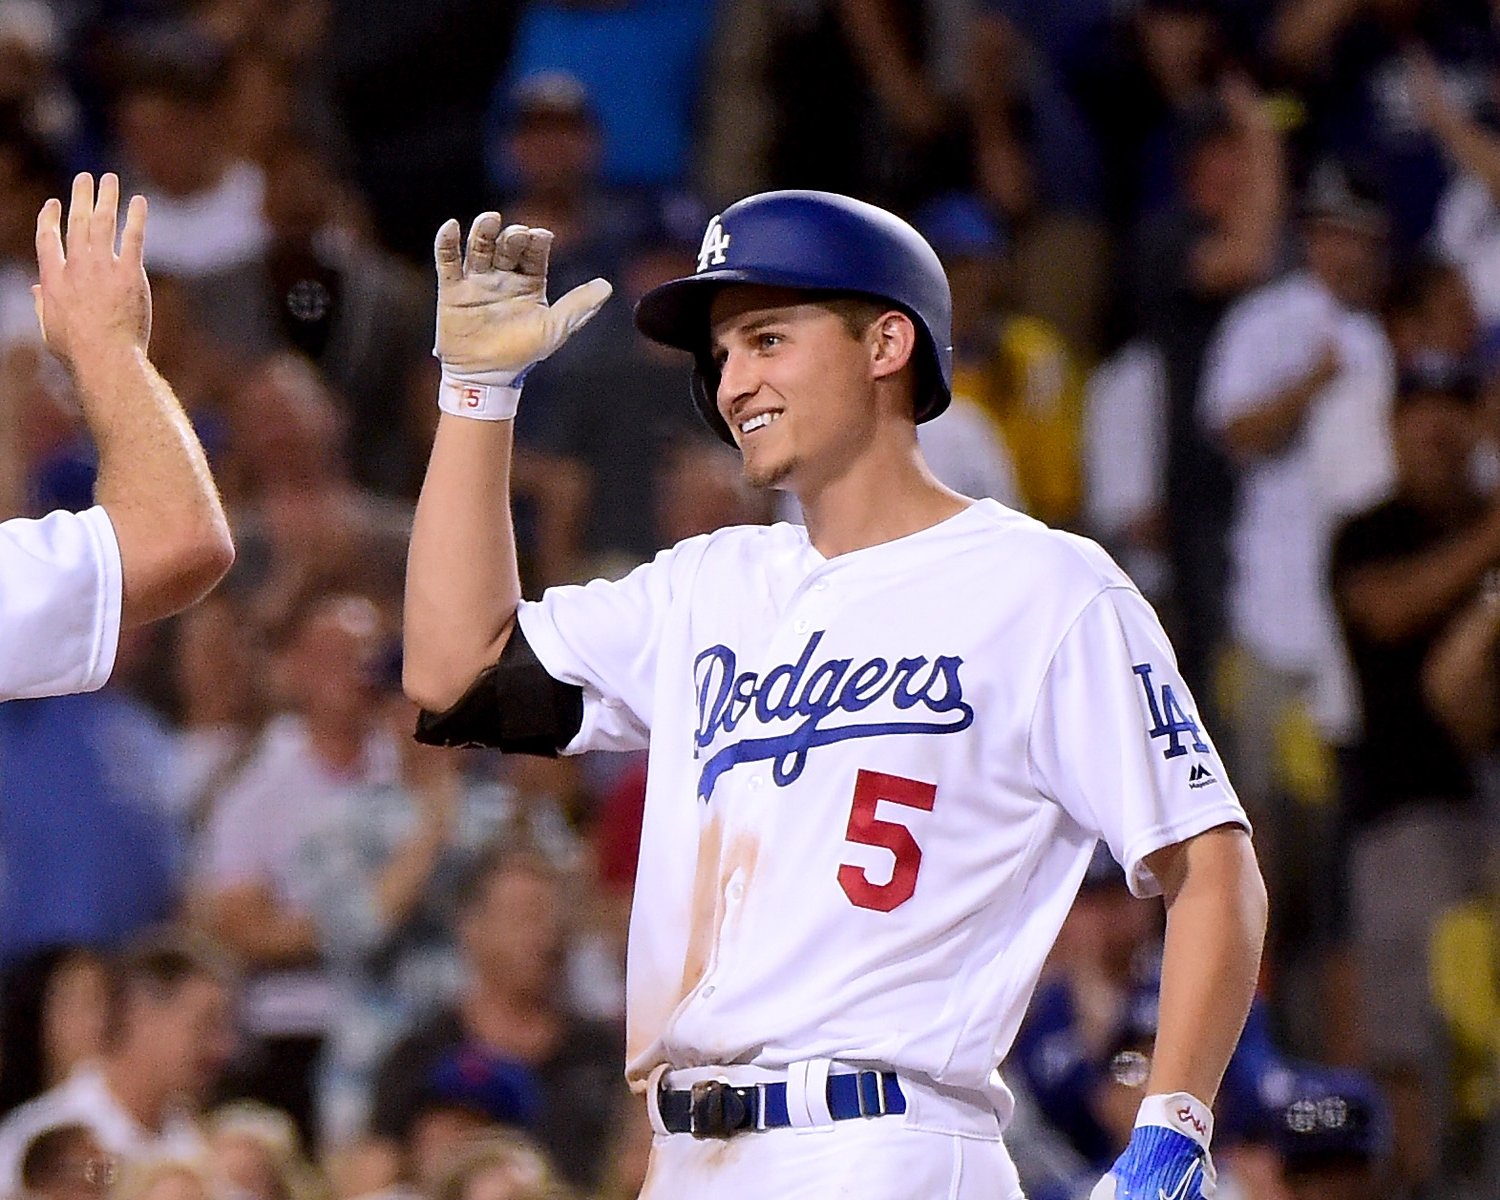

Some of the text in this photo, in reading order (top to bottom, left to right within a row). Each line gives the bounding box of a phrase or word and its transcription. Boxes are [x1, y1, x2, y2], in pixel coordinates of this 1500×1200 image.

[697, 214, 731, 273] LA
[467, 388, 481, 408] 5
[693, 630, 974, 788] Dodgers
[1132, 663, 1210, 760] LA
[836, 768, 938, 913] 5
